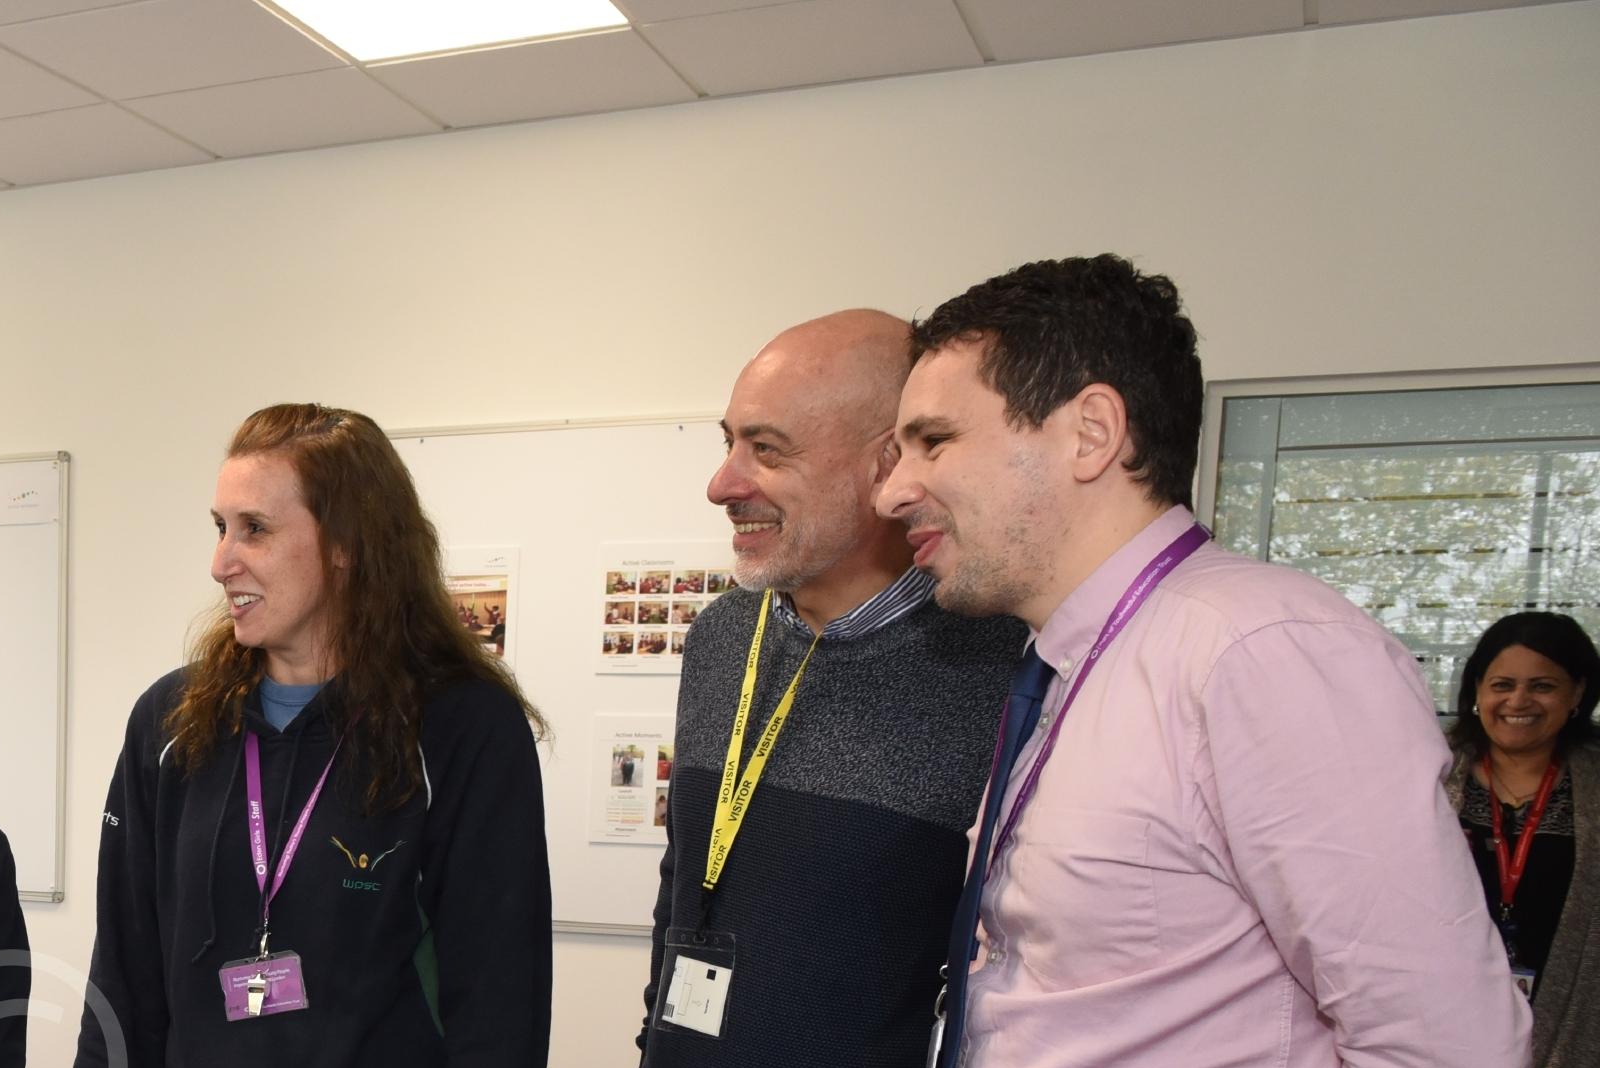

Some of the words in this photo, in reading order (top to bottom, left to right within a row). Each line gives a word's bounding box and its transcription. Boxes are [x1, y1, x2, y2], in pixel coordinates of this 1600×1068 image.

[748, 624, 763, 669] VISITOR
[733, 692, 750, 736] VISITOR
[756, 715, 783, 758] VISITOR
[721, 760, 736, 804] VISITOR
[728, 779, 753, 822] VISITOR
[250, 800, 260, 819] Staff
[709, 844, 727, 880] ISITOR
